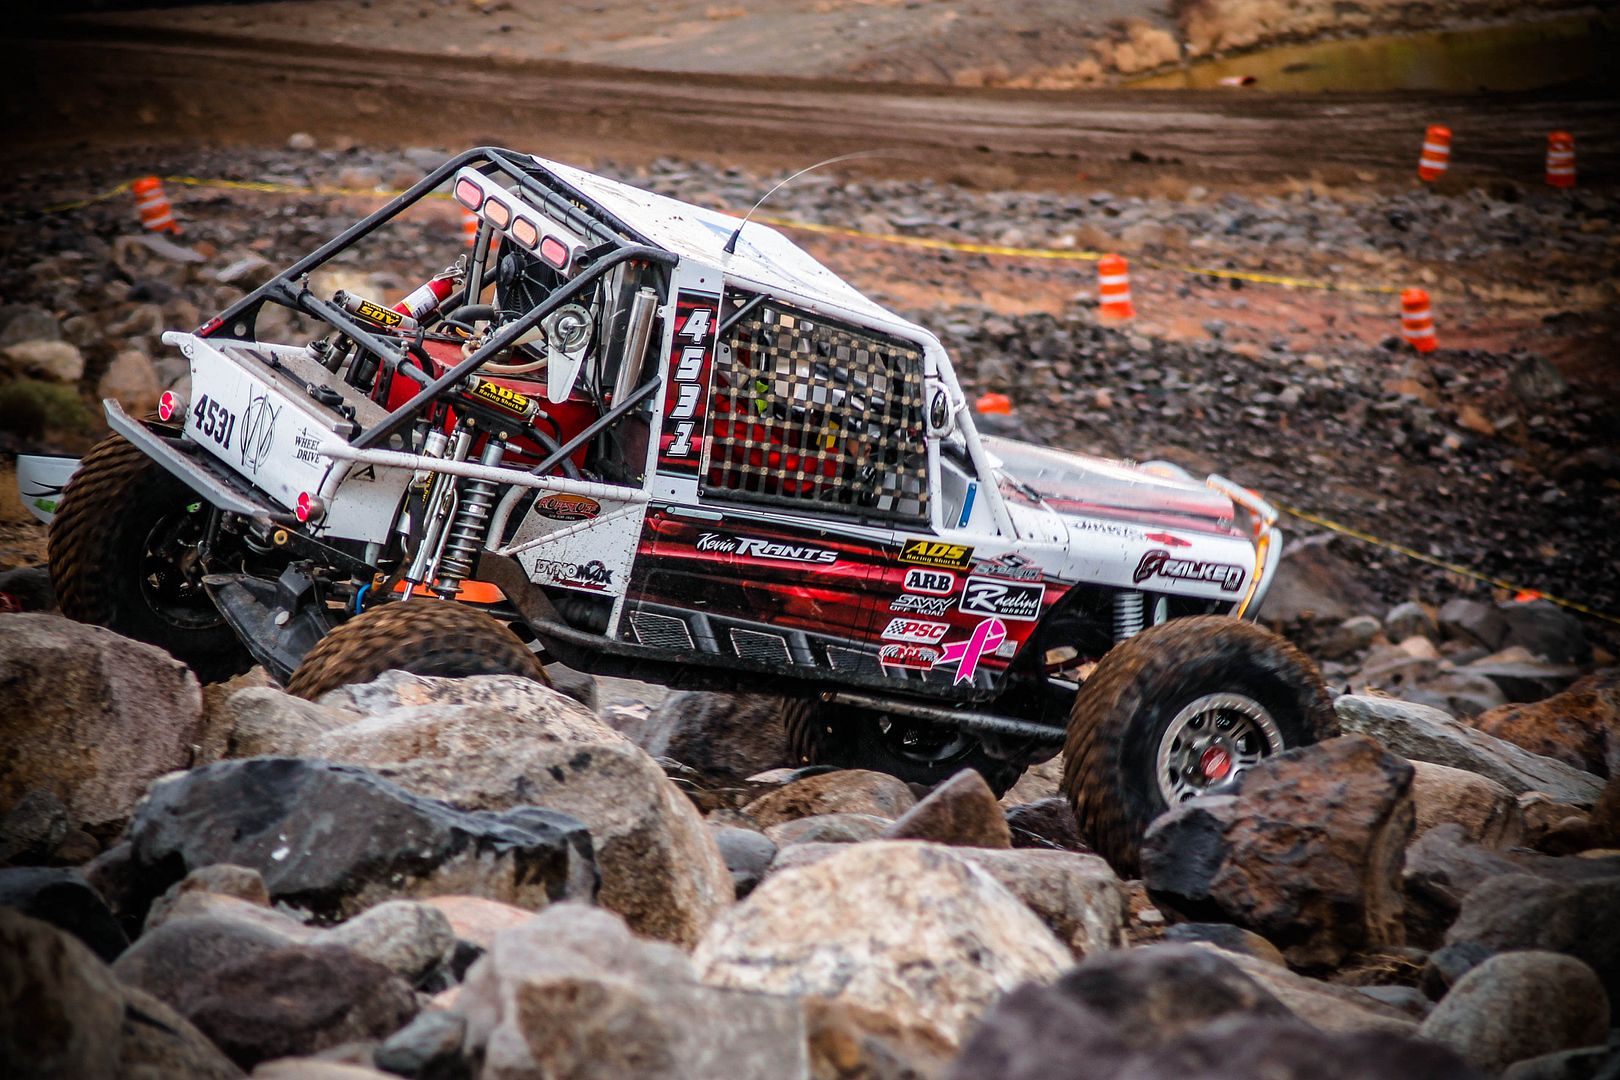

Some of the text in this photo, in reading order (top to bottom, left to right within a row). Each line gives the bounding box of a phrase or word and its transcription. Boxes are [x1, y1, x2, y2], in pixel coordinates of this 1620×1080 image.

[666, 308, 712, 457] 4531
[479, 388, 523, 412] Racing Shocks
[480, 382, 528, 406] ADS
[193, 393, 236, 450] 4531
[296, 449, 320, 464] DRIVE
[696, 532, 736, 552] Kevin
[905, 541, 968, 560] ADS
[905, 570, 951, 592] ARB
[1160, 558, 1243, 584] FALKEN
[891, 594, 957, 612] SAVVY
[966, 583, 1039, 612] Raceline
[889, 605, 945, 617] OFF ROAD
[901, 622, 947, 639] PSC
